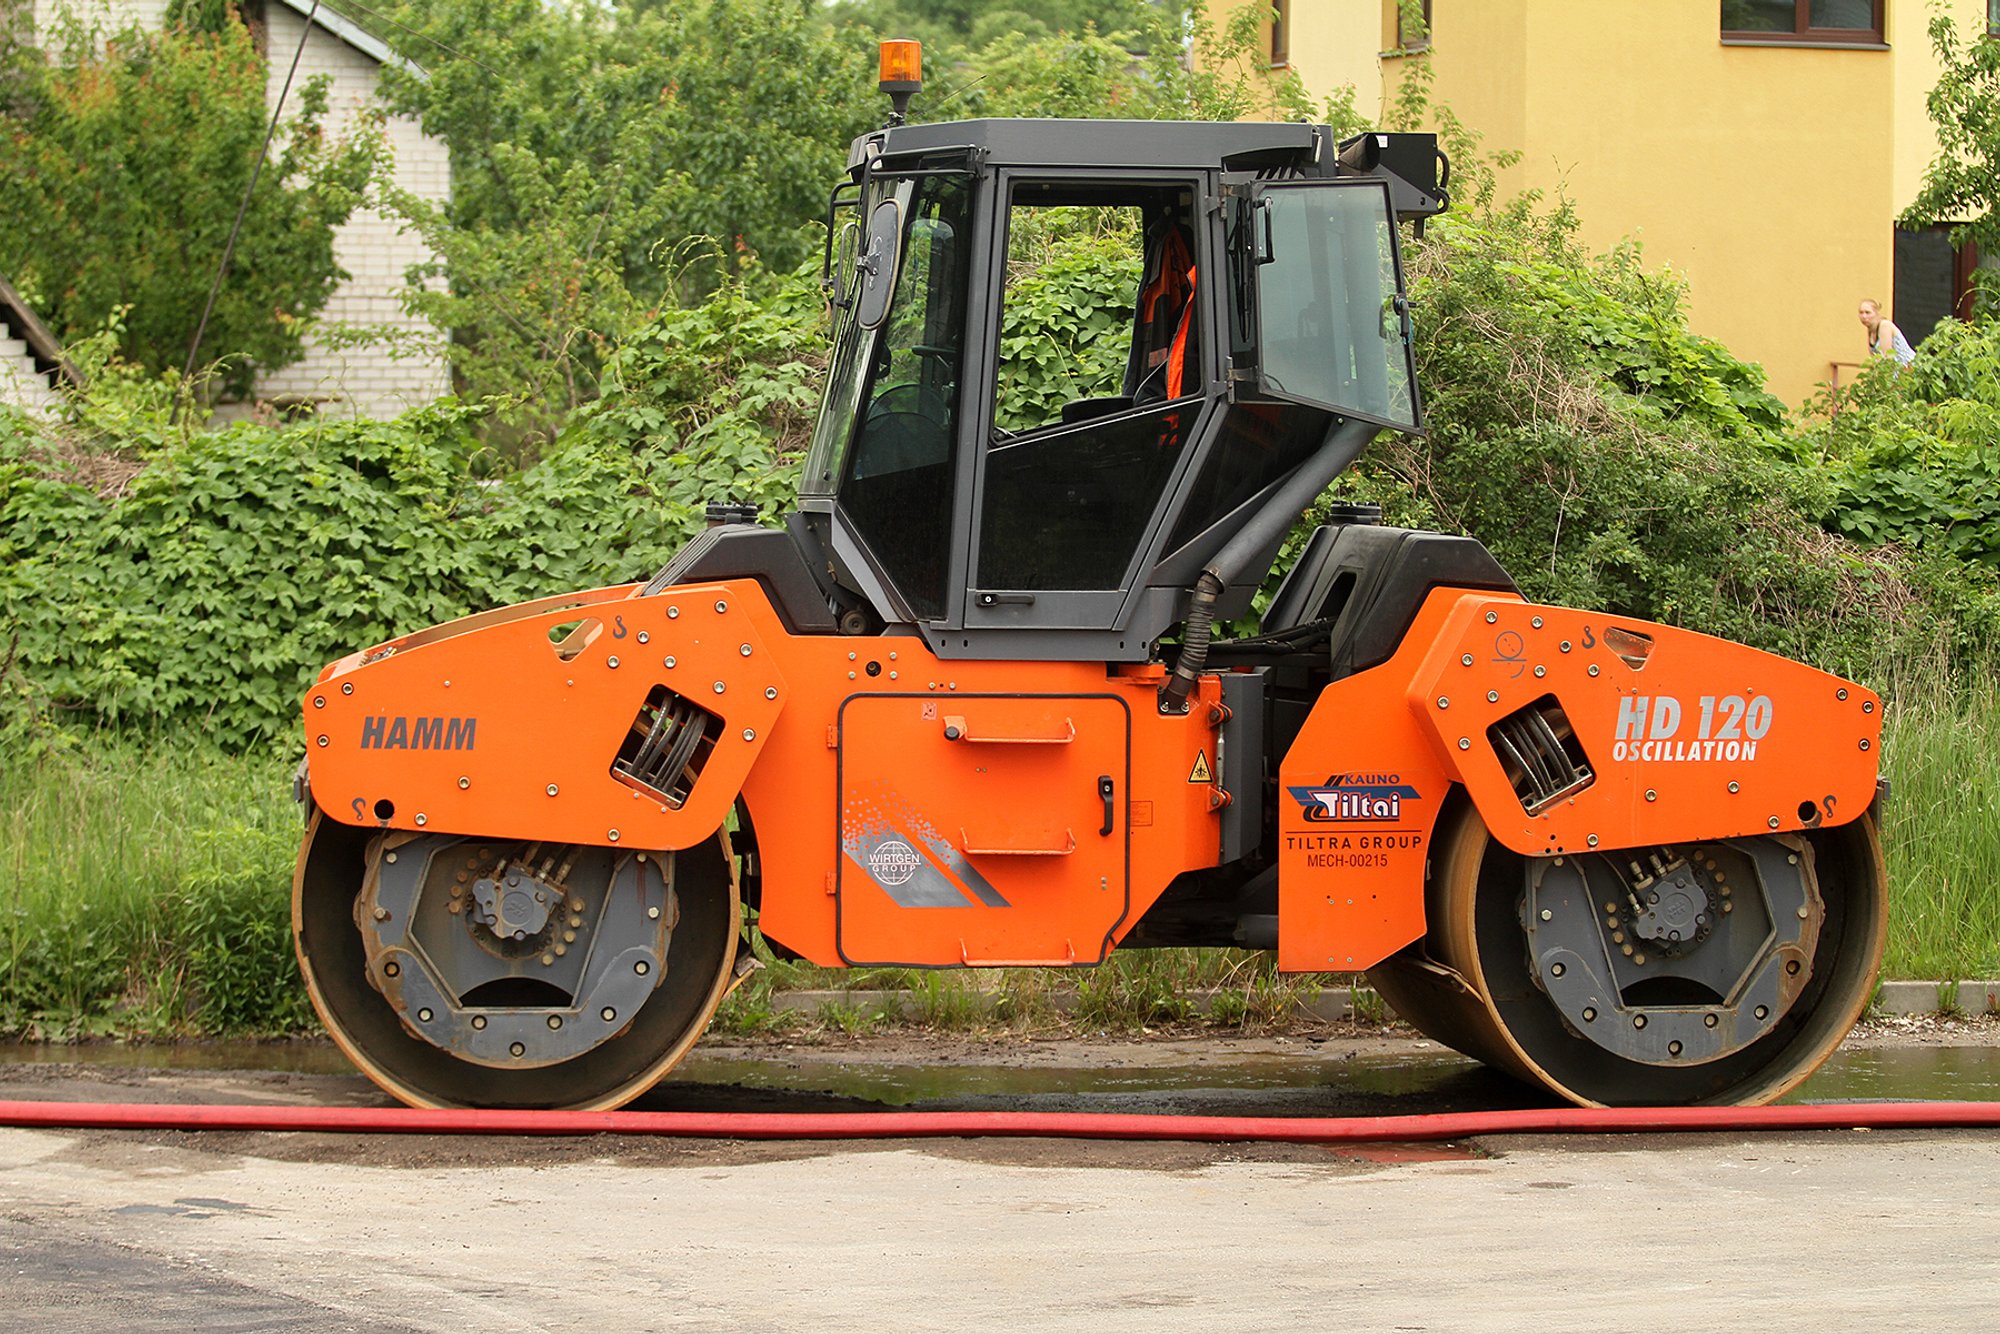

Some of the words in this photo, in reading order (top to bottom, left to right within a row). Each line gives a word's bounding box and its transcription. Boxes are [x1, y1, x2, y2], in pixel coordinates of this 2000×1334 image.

[1615, 696, 1681, 740] HD
[1698, 695, 1773, 740] 120
[361, 716, 477, 750] HAMM
[1612, 741, 1757, 762] OSCILLATION
[1345, 774, 1400, 785] KAUNO
[1311, 791, 1401, 820] Tiltai
[1287, 836, 1351, 850] TILTRA
[1360, 836, 1422, 850] GROUP
[869, 853, 920, 863] WIRTGEN
[1307, 853, 1388, 868] MECH-00215
[872, 864, 916, 872] GROUP
